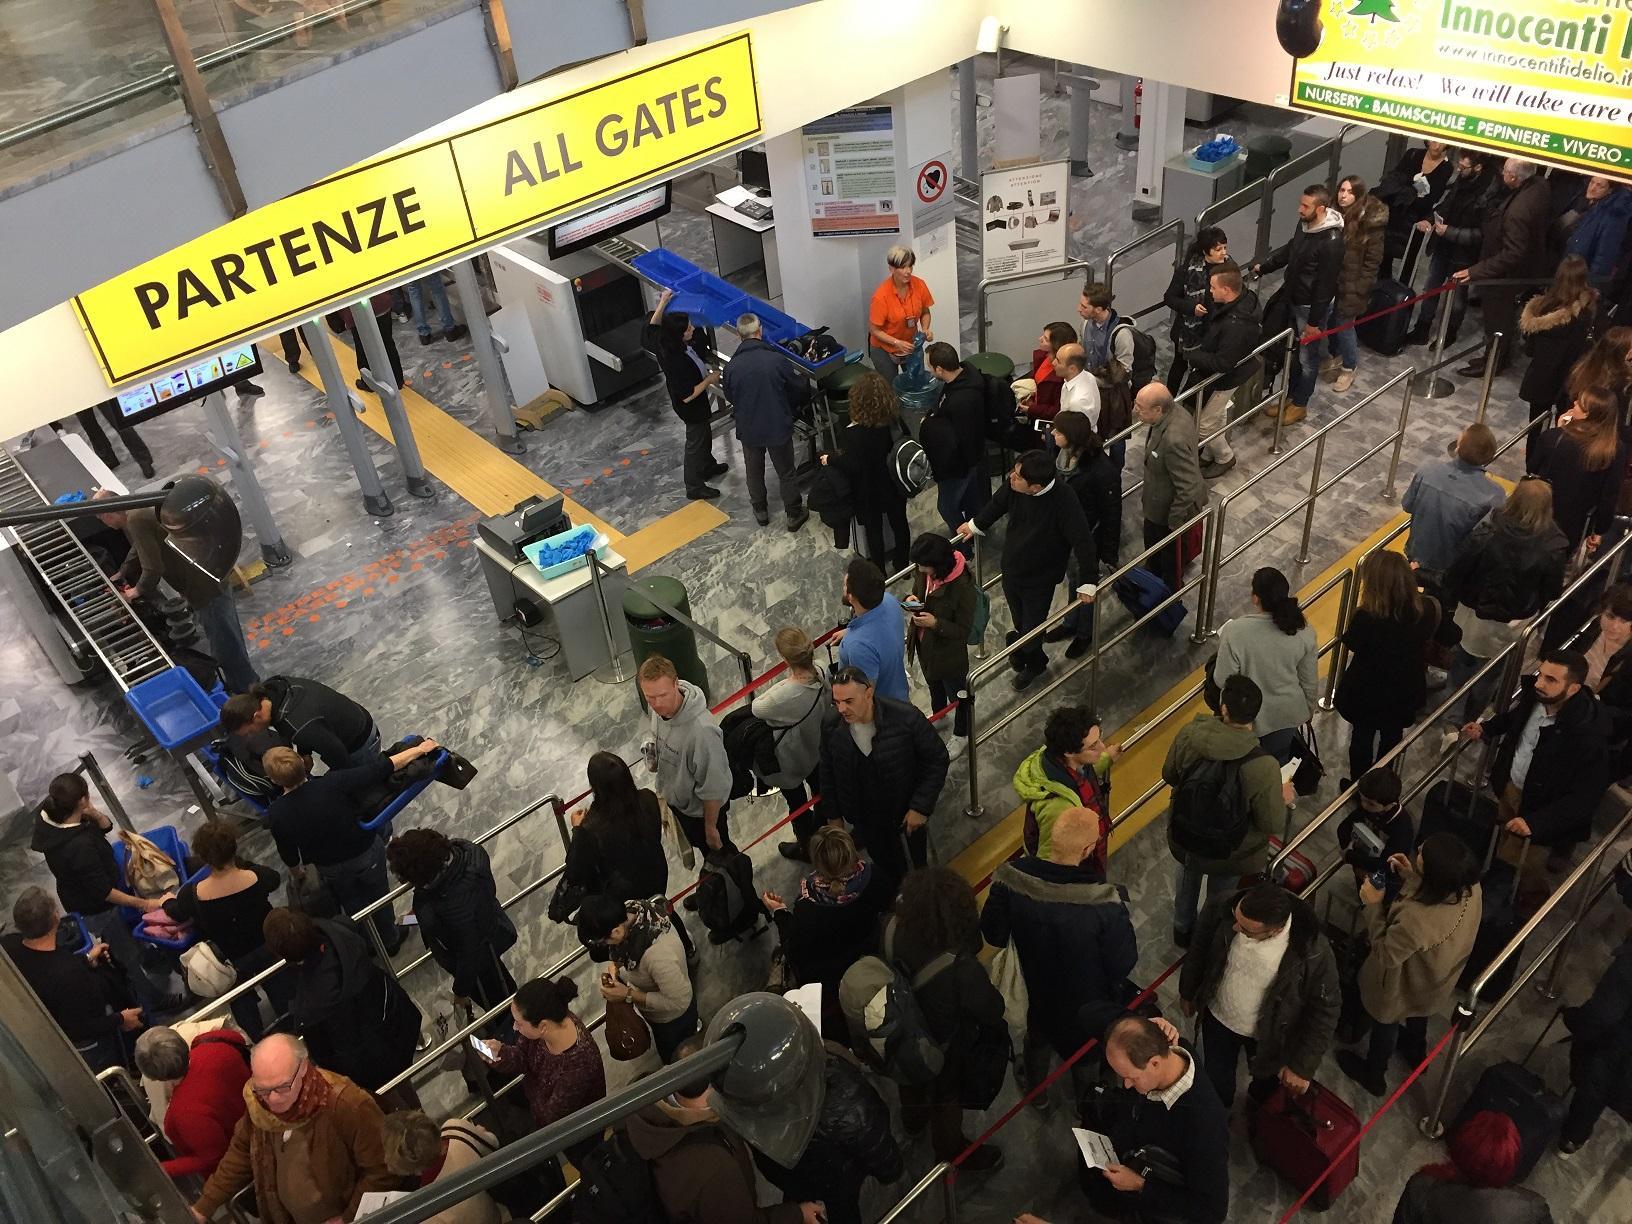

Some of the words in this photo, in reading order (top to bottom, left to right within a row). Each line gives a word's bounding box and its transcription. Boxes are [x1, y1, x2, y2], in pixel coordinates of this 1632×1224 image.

[1441, 0, 1612, 55] Innocenti
[1305, 85, 1364, 108] NURSERY
[1372, 100, 1467, 131] BAUMSCHULE
[1476, 120, 1551, 149] PEPINIERE
[1563, 138, 1622, 163] VIVERO
[1324, 61, 1362, 81] Just
[1366, 68, 1424, 90] relax!
[1441, 77, 1466, 97] We
[1472, 83, 1511, 104] will
[1515, 89, 1564, 112] take
[1569, 99, 1622, 121] care
[134, 187, 426, 329] PARTENZE
[504, 133, 583, 196] ALL
[595, 75, 727, 157] GATES
